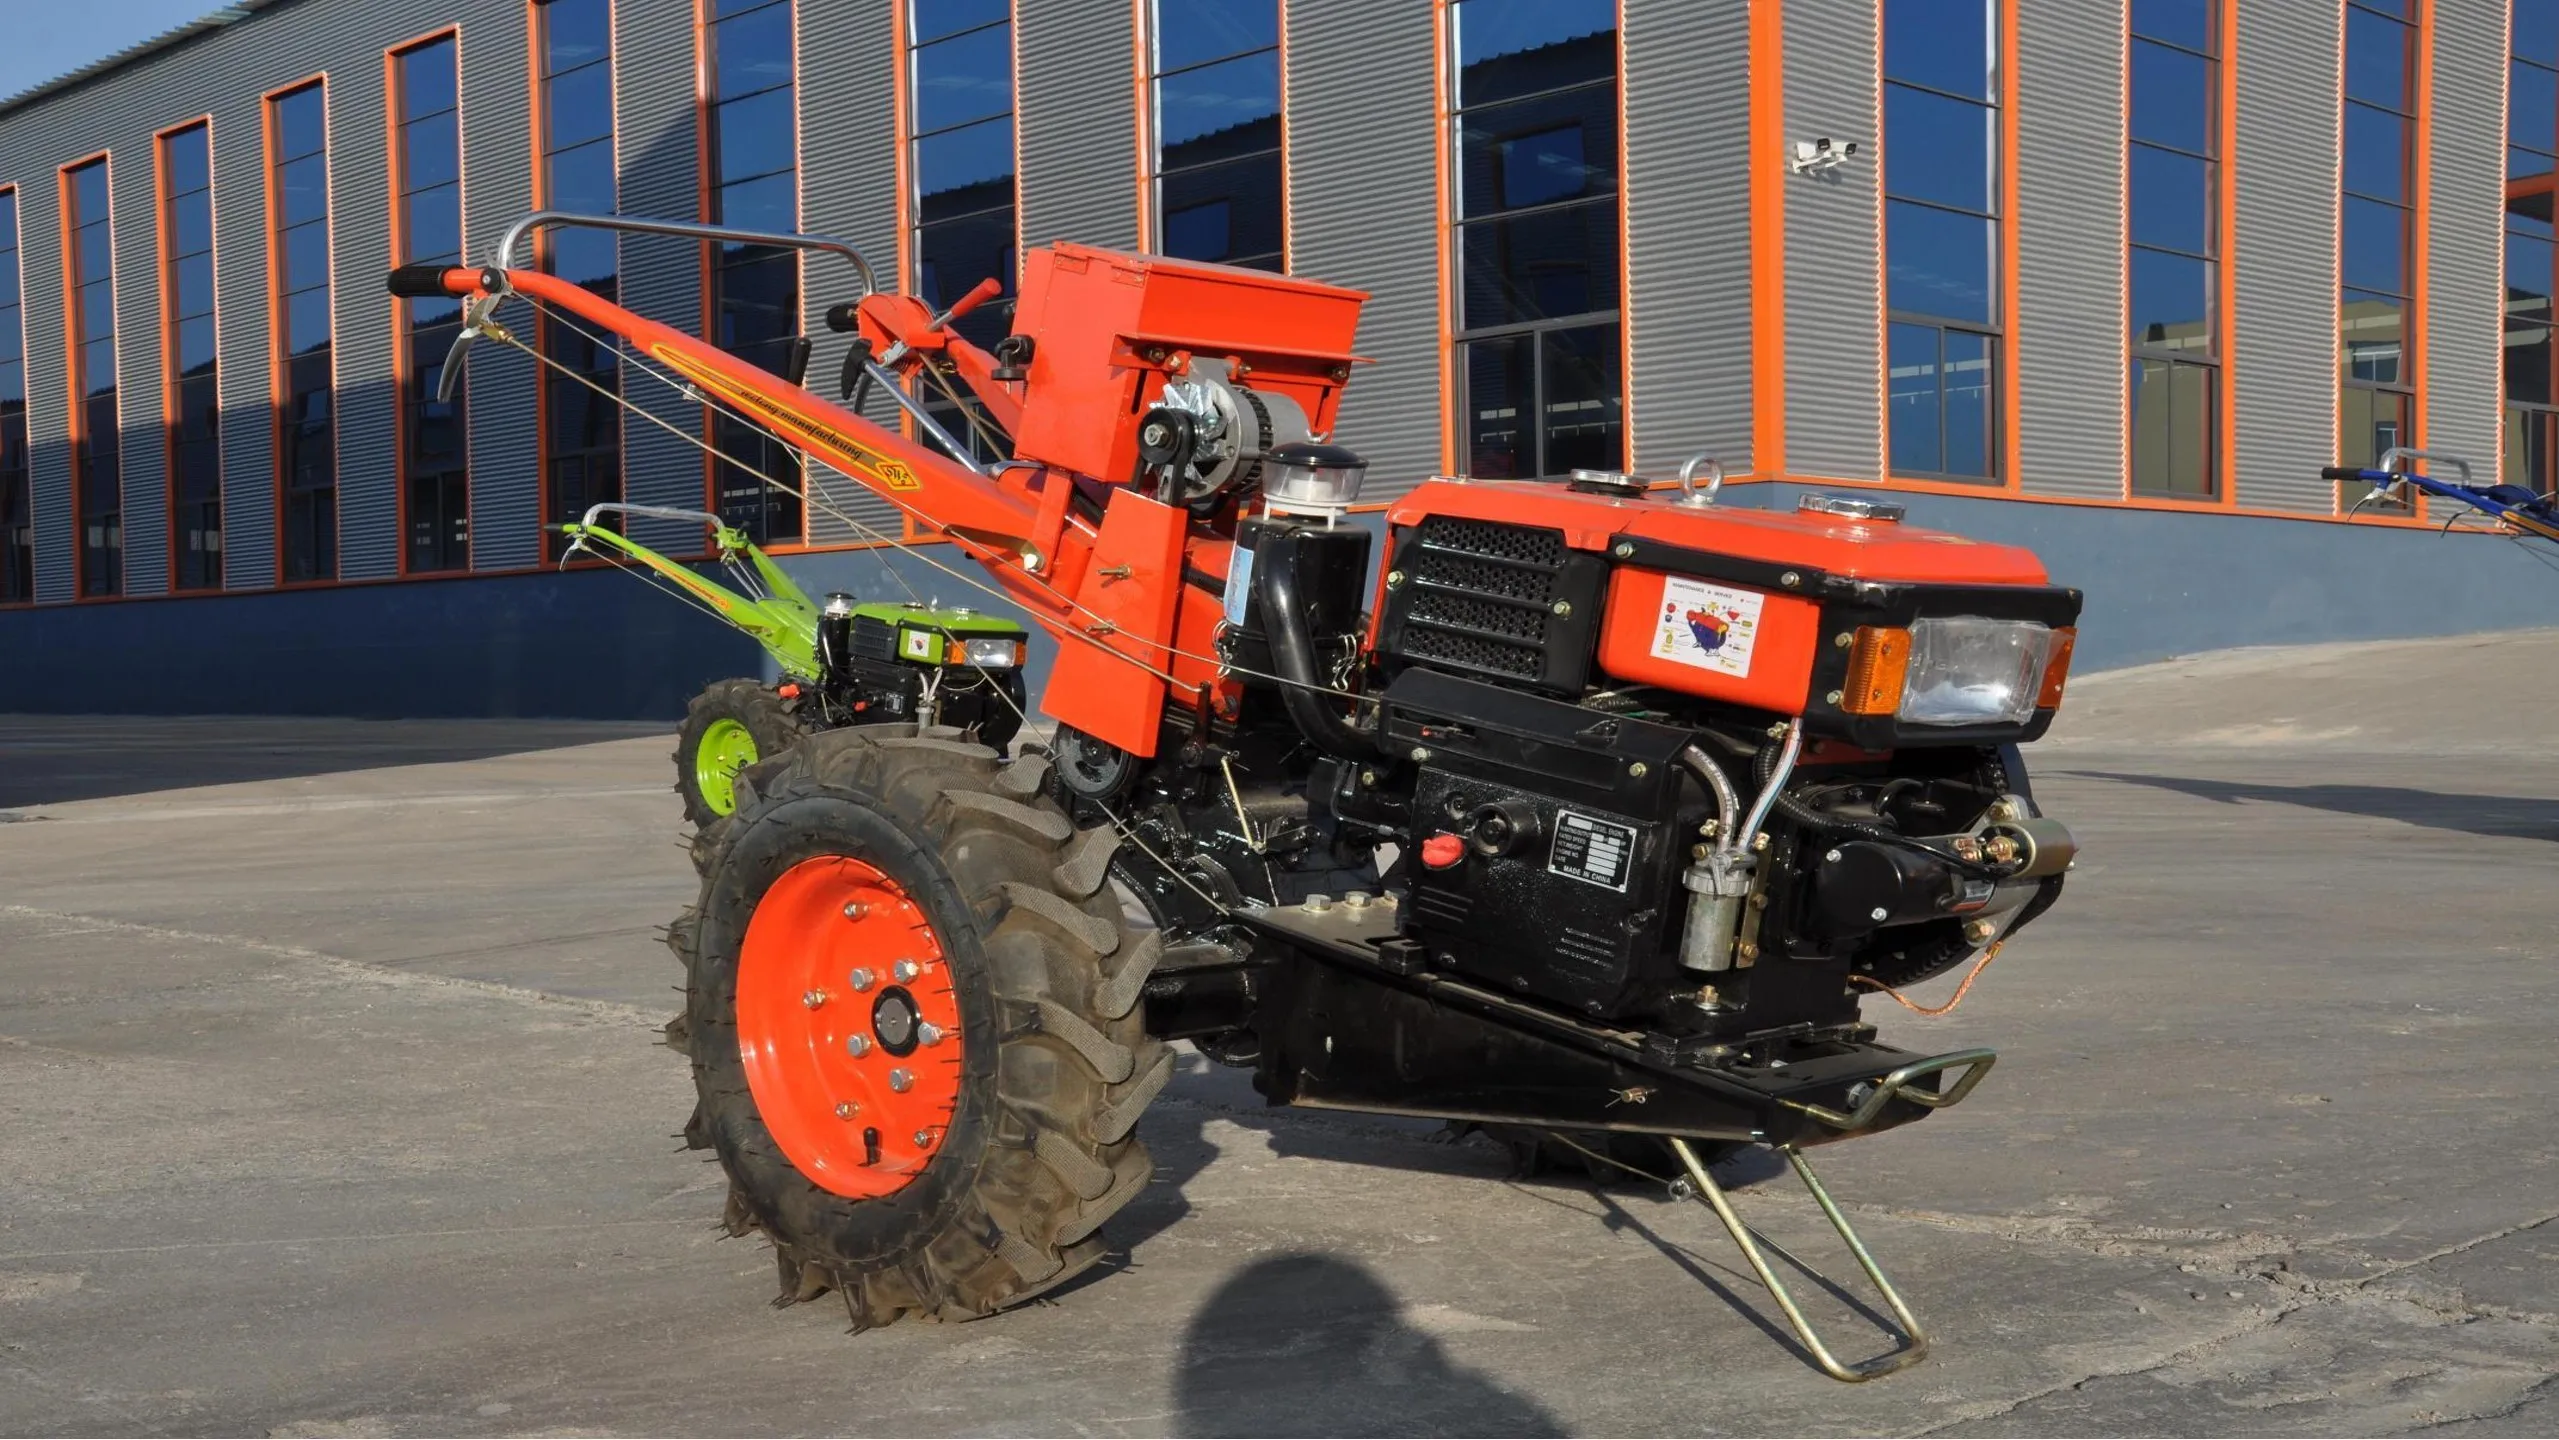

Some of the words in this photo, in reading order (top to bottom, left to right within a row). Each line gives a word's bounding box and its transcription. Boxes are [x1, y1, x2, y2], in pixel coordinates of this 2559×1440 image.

[1563, 865, 1581, 875] MADE
[1582, 870, 1590, 878] IN
[1591, 873, 1611, 884] CHINA
